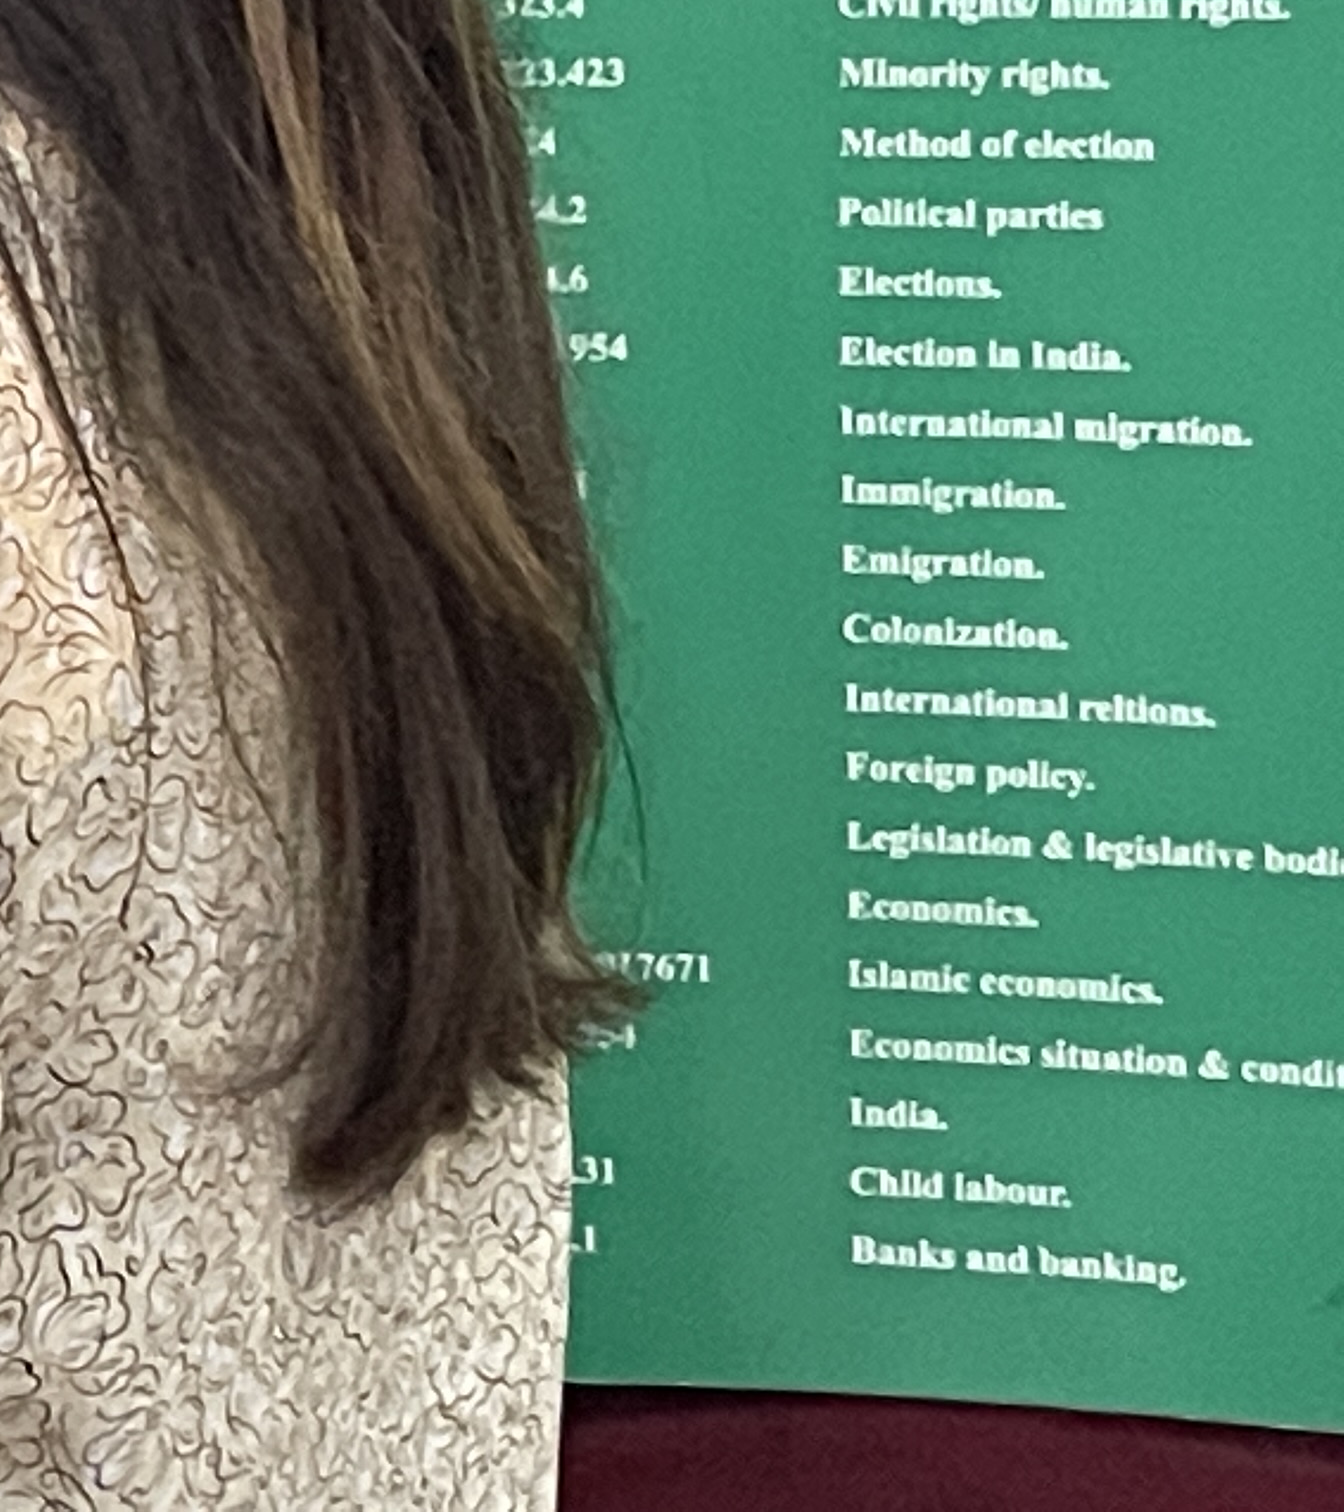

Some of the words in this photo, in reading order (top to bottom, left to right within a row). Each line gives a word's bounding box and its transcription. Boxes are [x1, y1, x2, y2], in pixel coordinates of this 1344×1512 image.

[839, 57, 991, 96] Minority
[1001, 58, 1111, 96] rights.
[839, 127, 972, 159] Method
[980, 128, 1019, 159] of
[1023, 129, 1155, 161] election
[839, 196, 977, 229] Political
[986, 200, 1104, 237] parties
[838, 265, 1003, 299] Elections.
[839, 335, 978, 368] Election
[988, 339, 1021, 369] in
[1031, 340, 1132, 372] India.
[840, 404, 1065, 441] International
[1074, 411, 1253, 451] migration.
[841, 474, 1066, 514] Immigration.
[842, 544, 1045, 584] Emigration.
[842, 612, 1069, 651] Colonization.
[846, 682, 1069, 720] International
[1079, 693, 1217, 728] reltions.
[846, 751, 976, 793] Foreign
[986, 759, 1095, 799] policy.
[847, 820, 1032, 860] Legislation
[1041, 829, 1073, 860] &
[1085, 831, 1255, 871] legislative
[848, 890, 1040, 928] Economics.
[848, 958, 971, 994] Islamic
[979, 972, 1164, 1005] economics.
[850, 1028, 1031, 1066] Economics
[1040, 1038, 1188, 1078] situation
[1197, 1049, 1230, 1080] &
[850, 1097, 949, 1131] India.
[849, 1166, 944, 1199] Child
[954, 1171, 1072, 1208] labour.
[851, 1235, 956, 1270] Banks
[965, 1244, 1030, 1274] and
[1037, 1245, 1187, 1293] banking.
